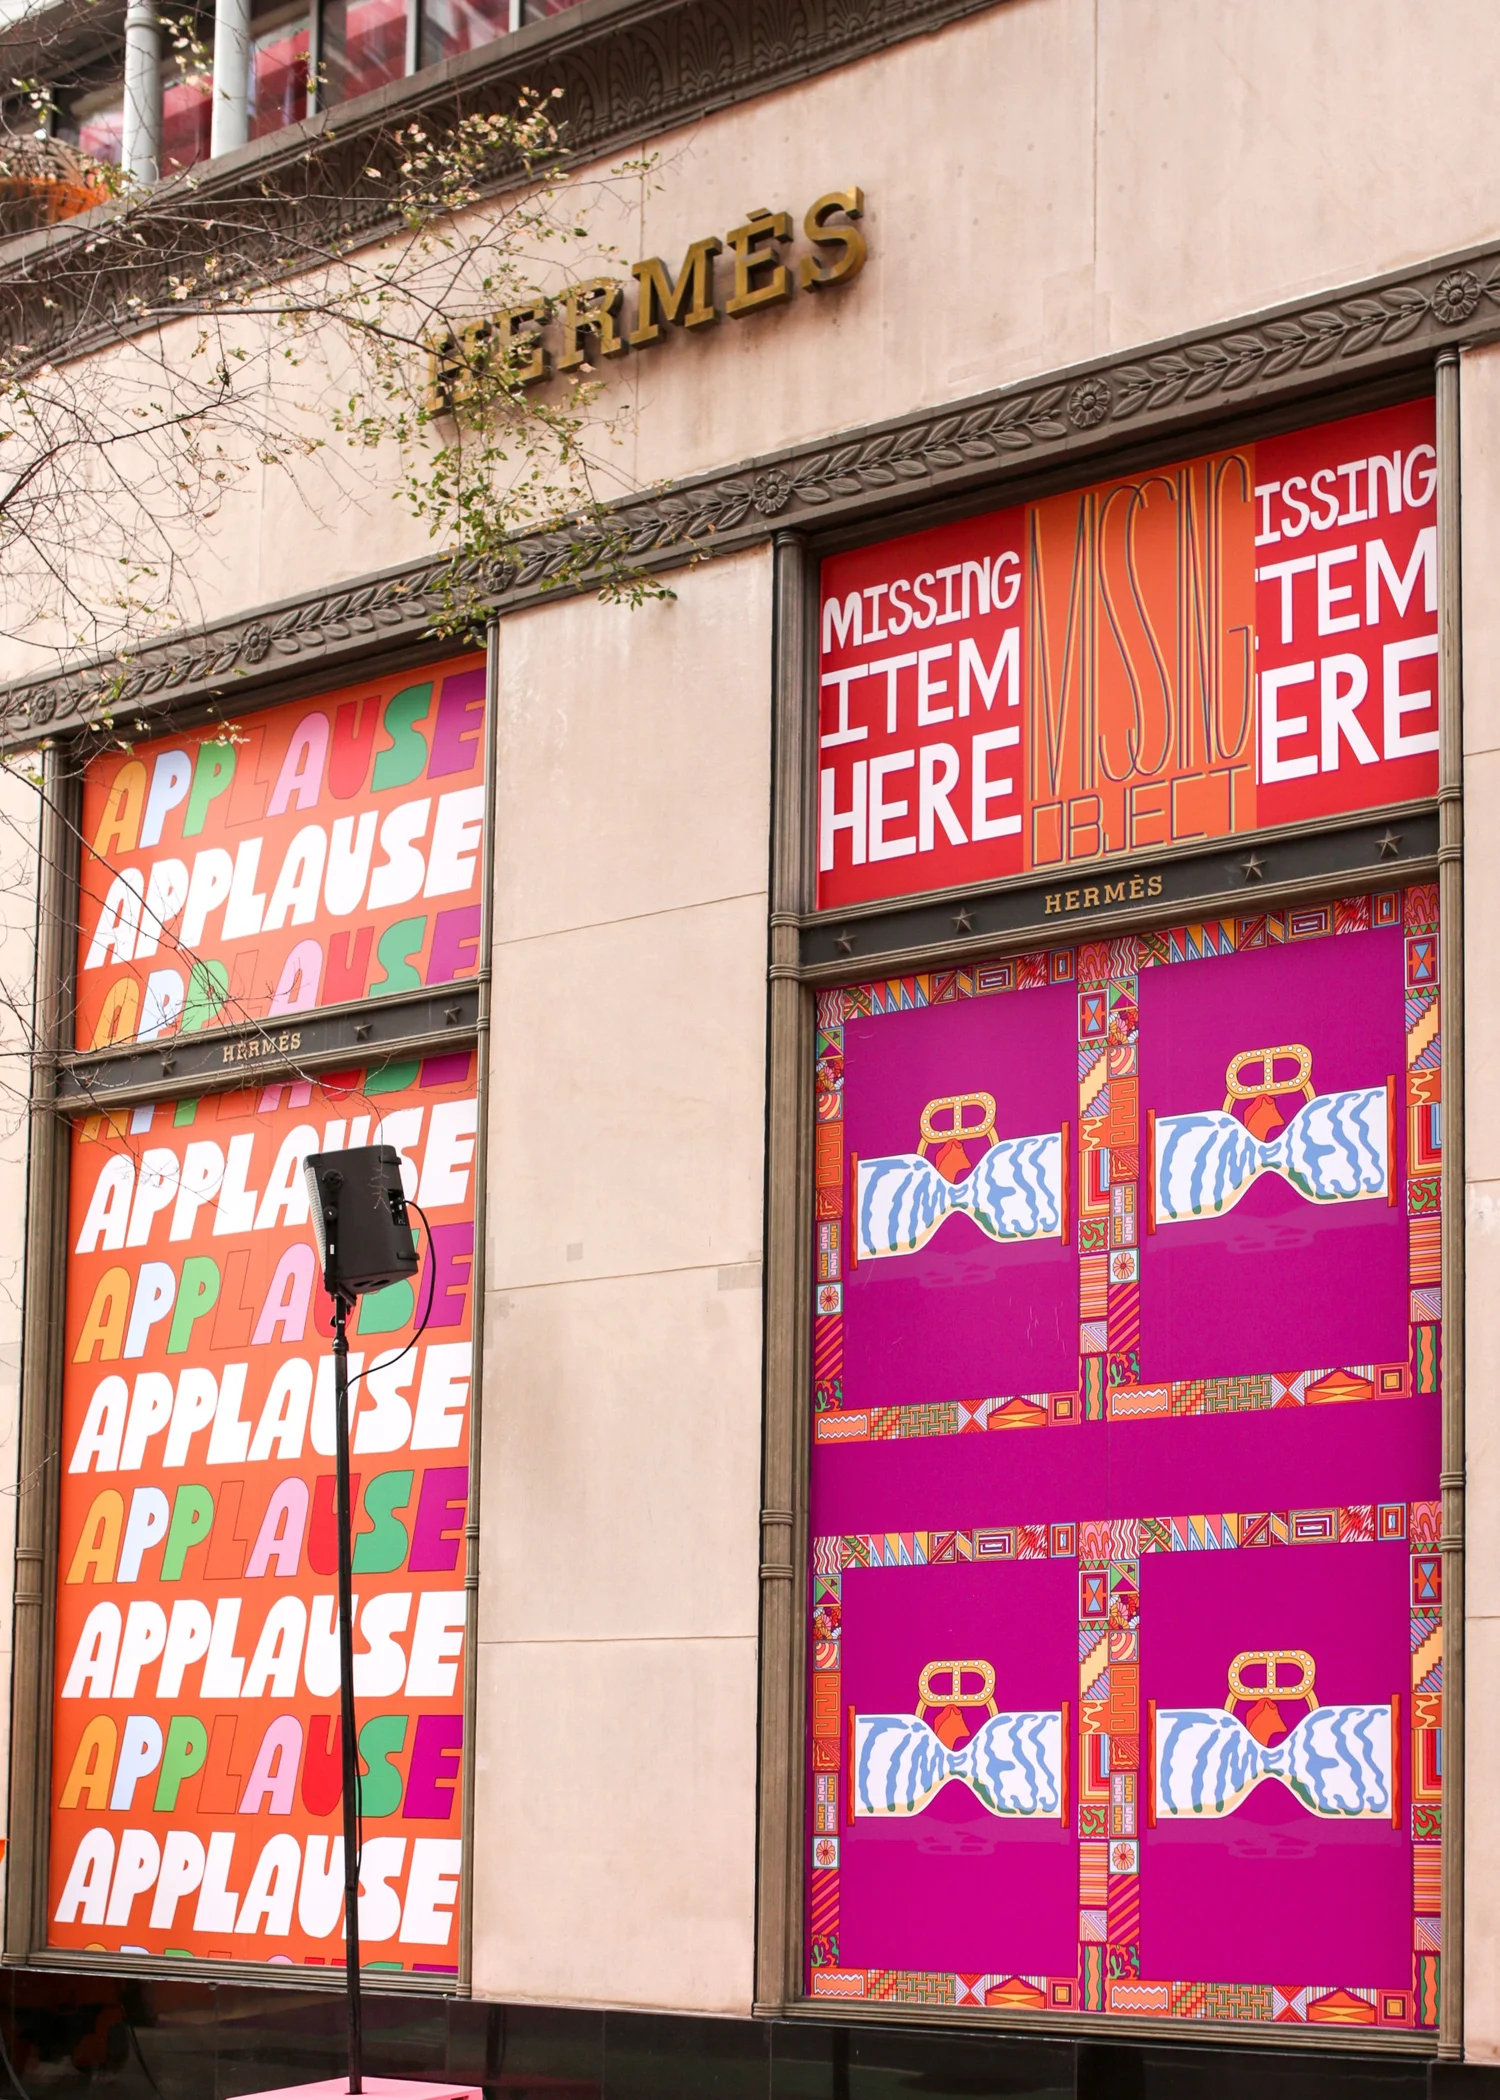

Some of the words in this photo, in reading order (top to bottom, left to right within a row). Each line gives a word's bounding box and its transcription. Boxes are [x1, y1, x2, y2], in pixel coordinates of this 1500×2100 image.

[822, 550, 1021, 654] MISSING
[1029, 454, 1253, 801] MISSING
[1255, 525, 1438, 650] TEM
[821, 626, 1020, 748] ITEM
[1255, 633, 1439, 785] ERE
[88, 667, 487, 861] APPLAUSE
[820, 725, 1022, 872] HERE
[1032, 763, 1251, 870] OBJECT
[84, 785, 485, 971] APPLAUSE
[1044, 874, 1163, 915] HERMÈS
[68, 1341, 472, 1474] APPLAUSE
[65, 1466, 469, 1585] APPLAUSE
[61, 1590, 466, 1698] APPLAUSE
[57, 1714, 464, 1820] APPLAUSE
[54, 1827, 462, 1945] APPLAUSE
